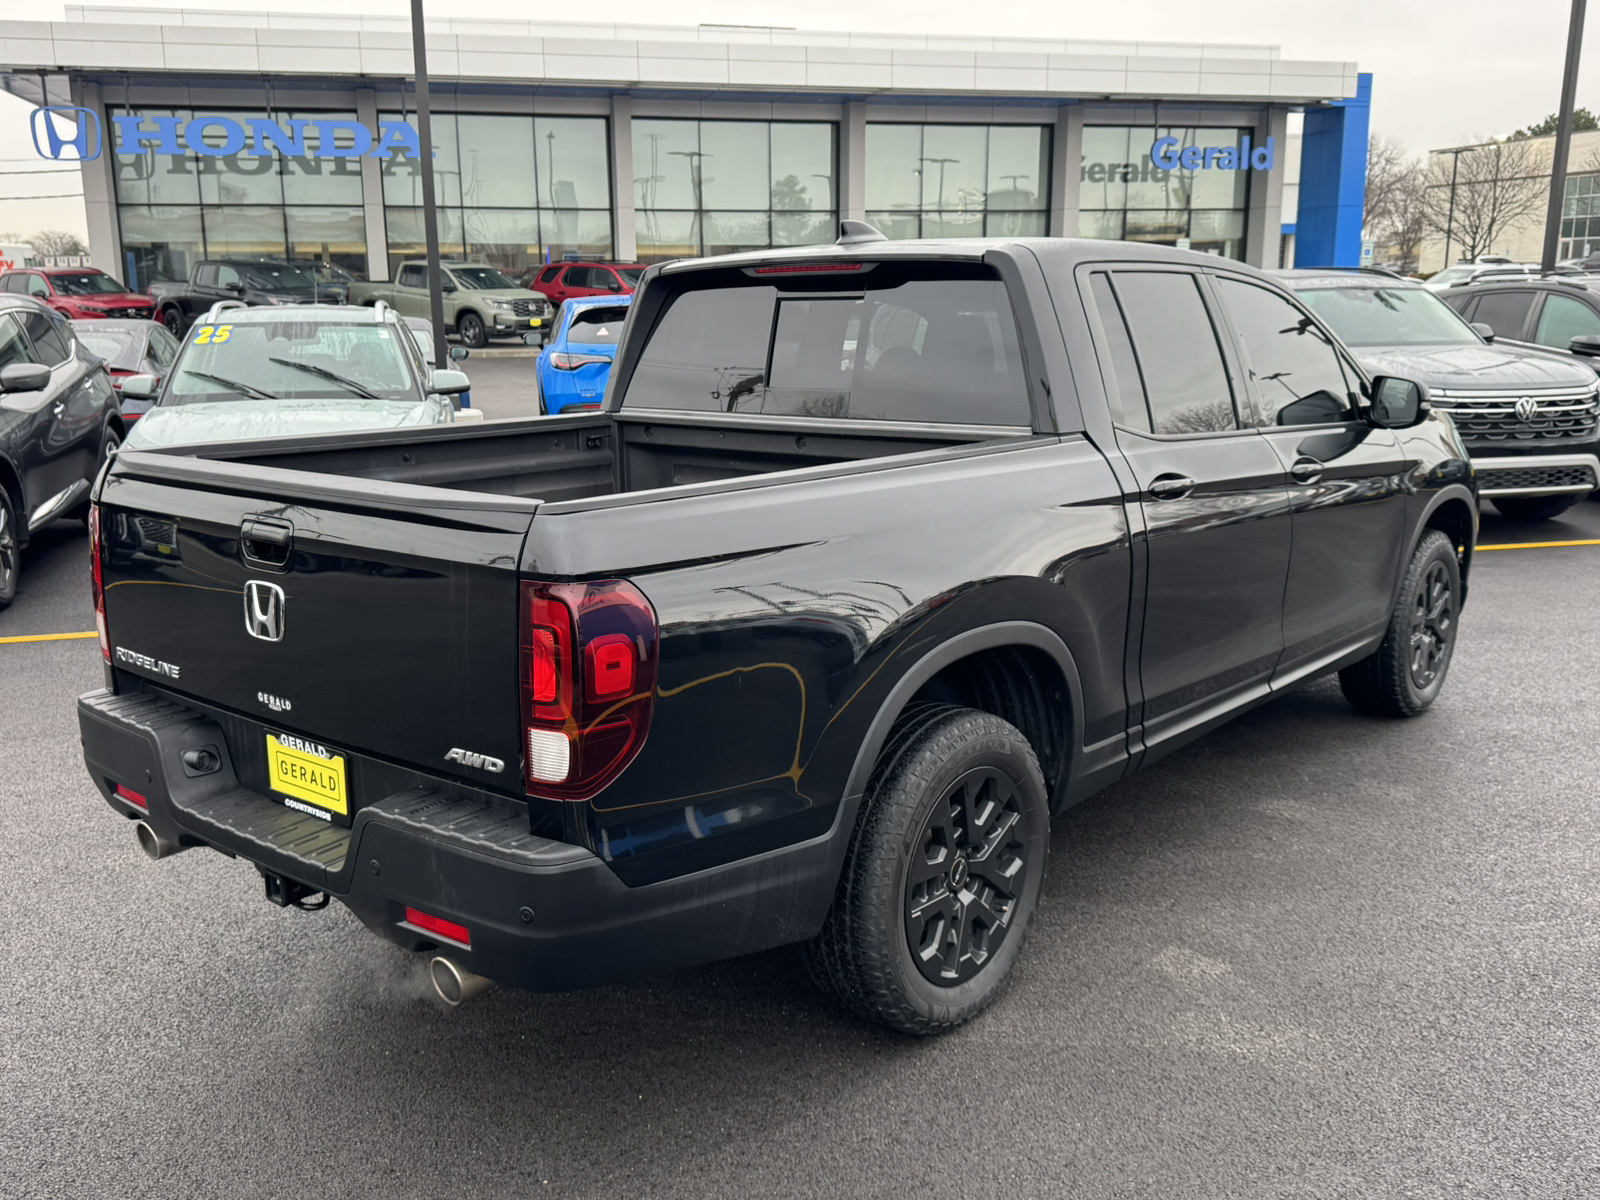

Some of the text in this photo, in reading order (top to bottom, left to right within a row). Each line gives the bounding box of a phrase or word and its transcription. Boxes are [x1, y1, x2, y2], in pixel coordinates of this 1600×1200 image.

[112, 116, 436, 158] HONDA
[1151, 135, 1275, 171] Gerald
[193, 325, 234, 345] 25
[116, 646, 182, 679] RIDGELINE
[257, 691, 292, 711] GERALD
[280, 733, 328, 758] GERALD
[443, 747, 505, 773] AWD
[280, 760, 337, 792] GERALD
[284, 798, 333, 821] COUNTRYSIDE
